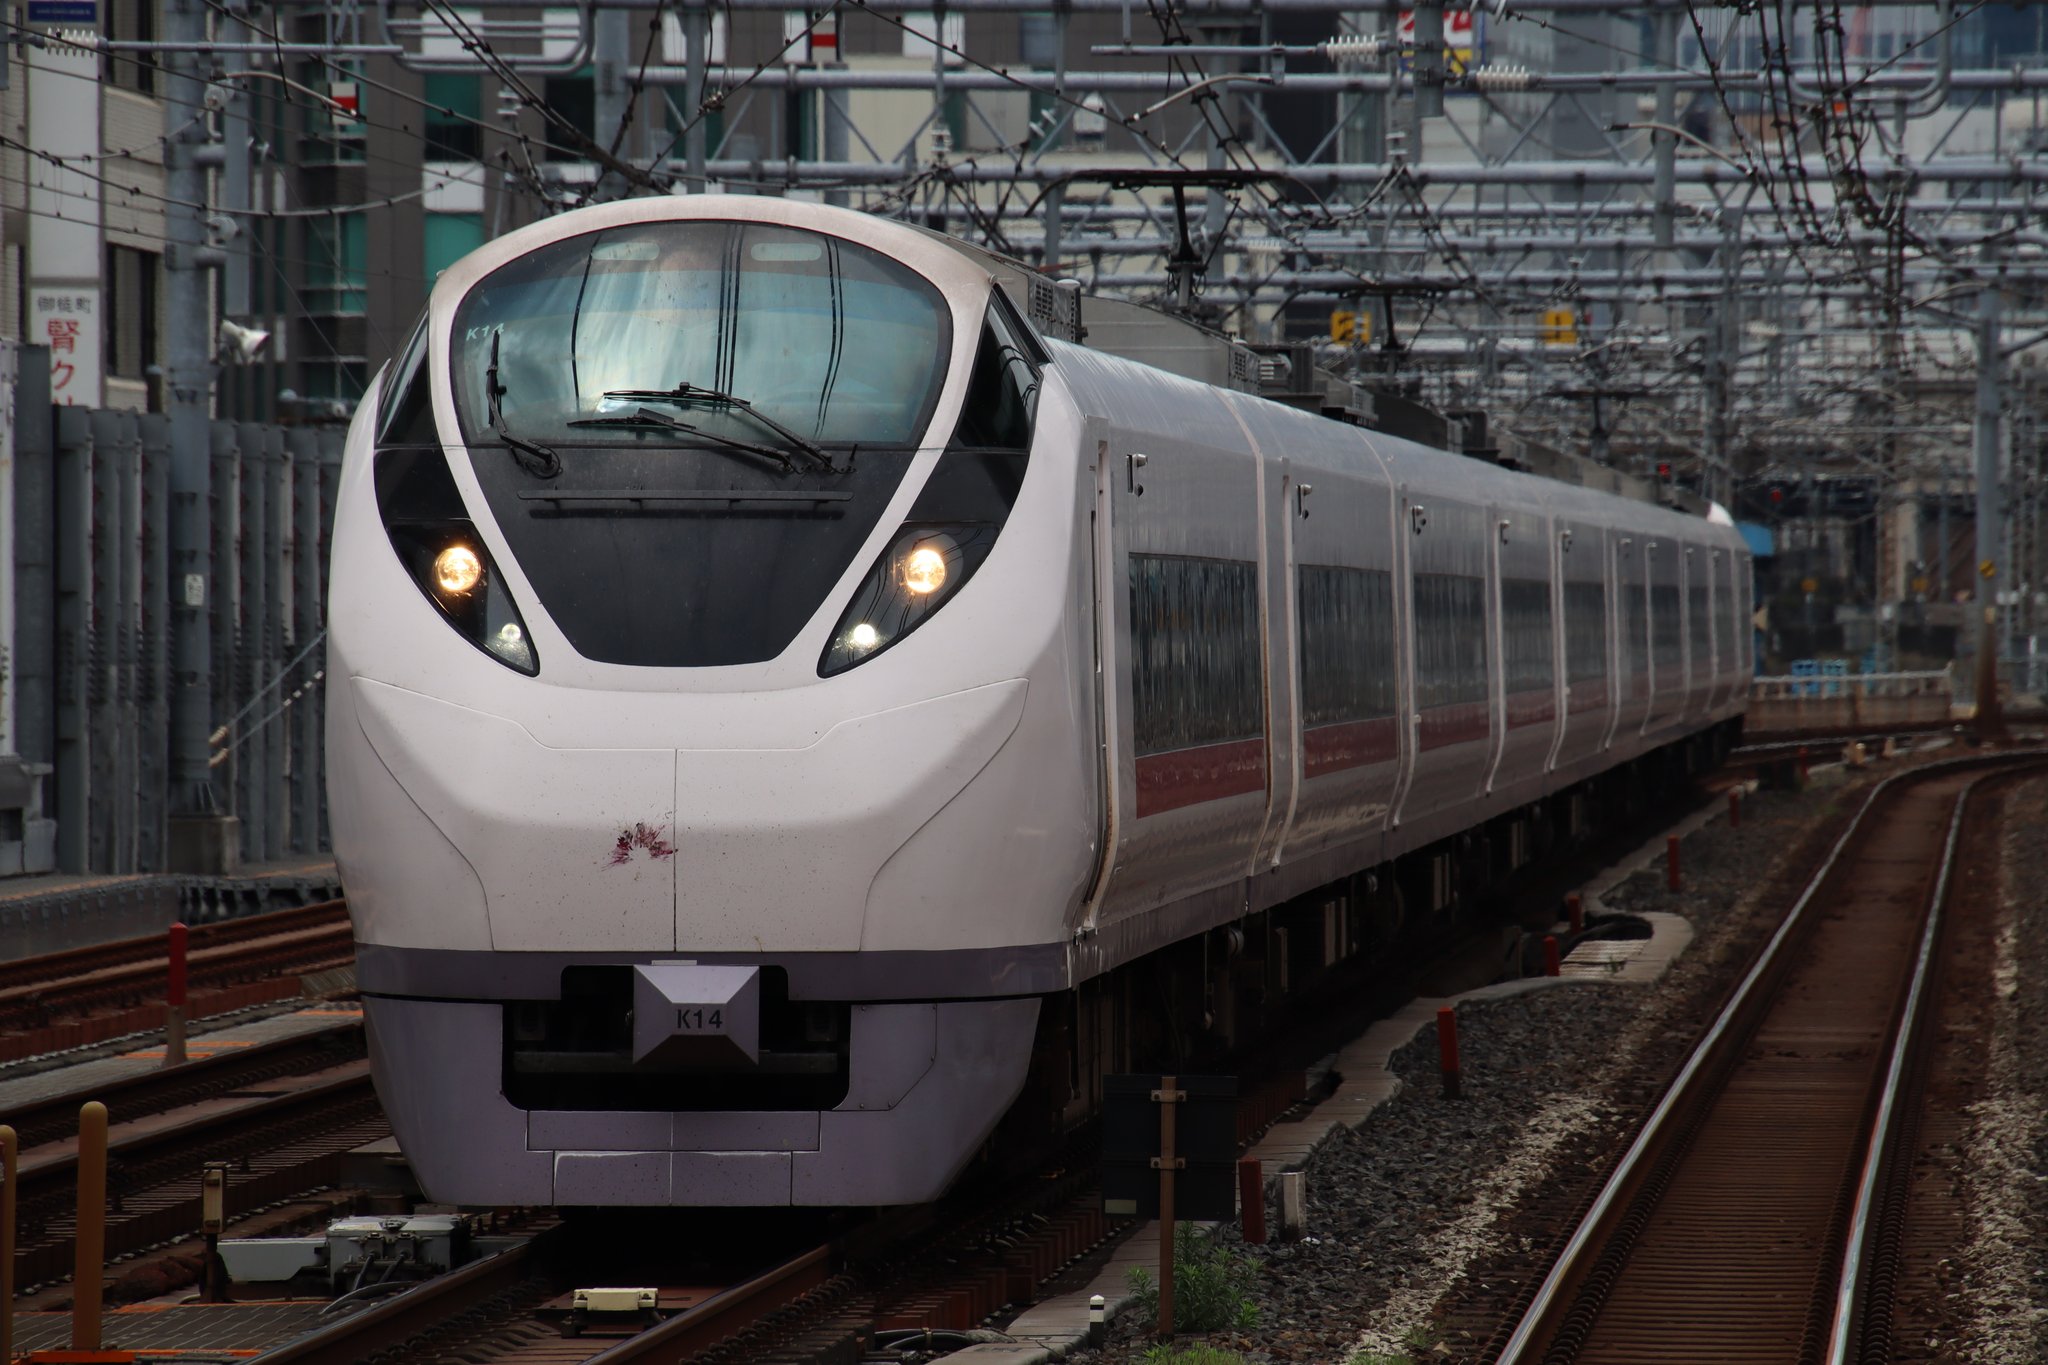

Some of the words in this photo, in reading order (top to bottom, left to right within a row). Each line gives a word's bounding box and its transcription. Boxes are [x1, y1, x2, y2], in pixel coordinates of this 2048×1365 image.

[37, 295, 91, 314] 御徒町
[466, 322, 505, 341] K14
[677, 1008, 722, 1029] K14
